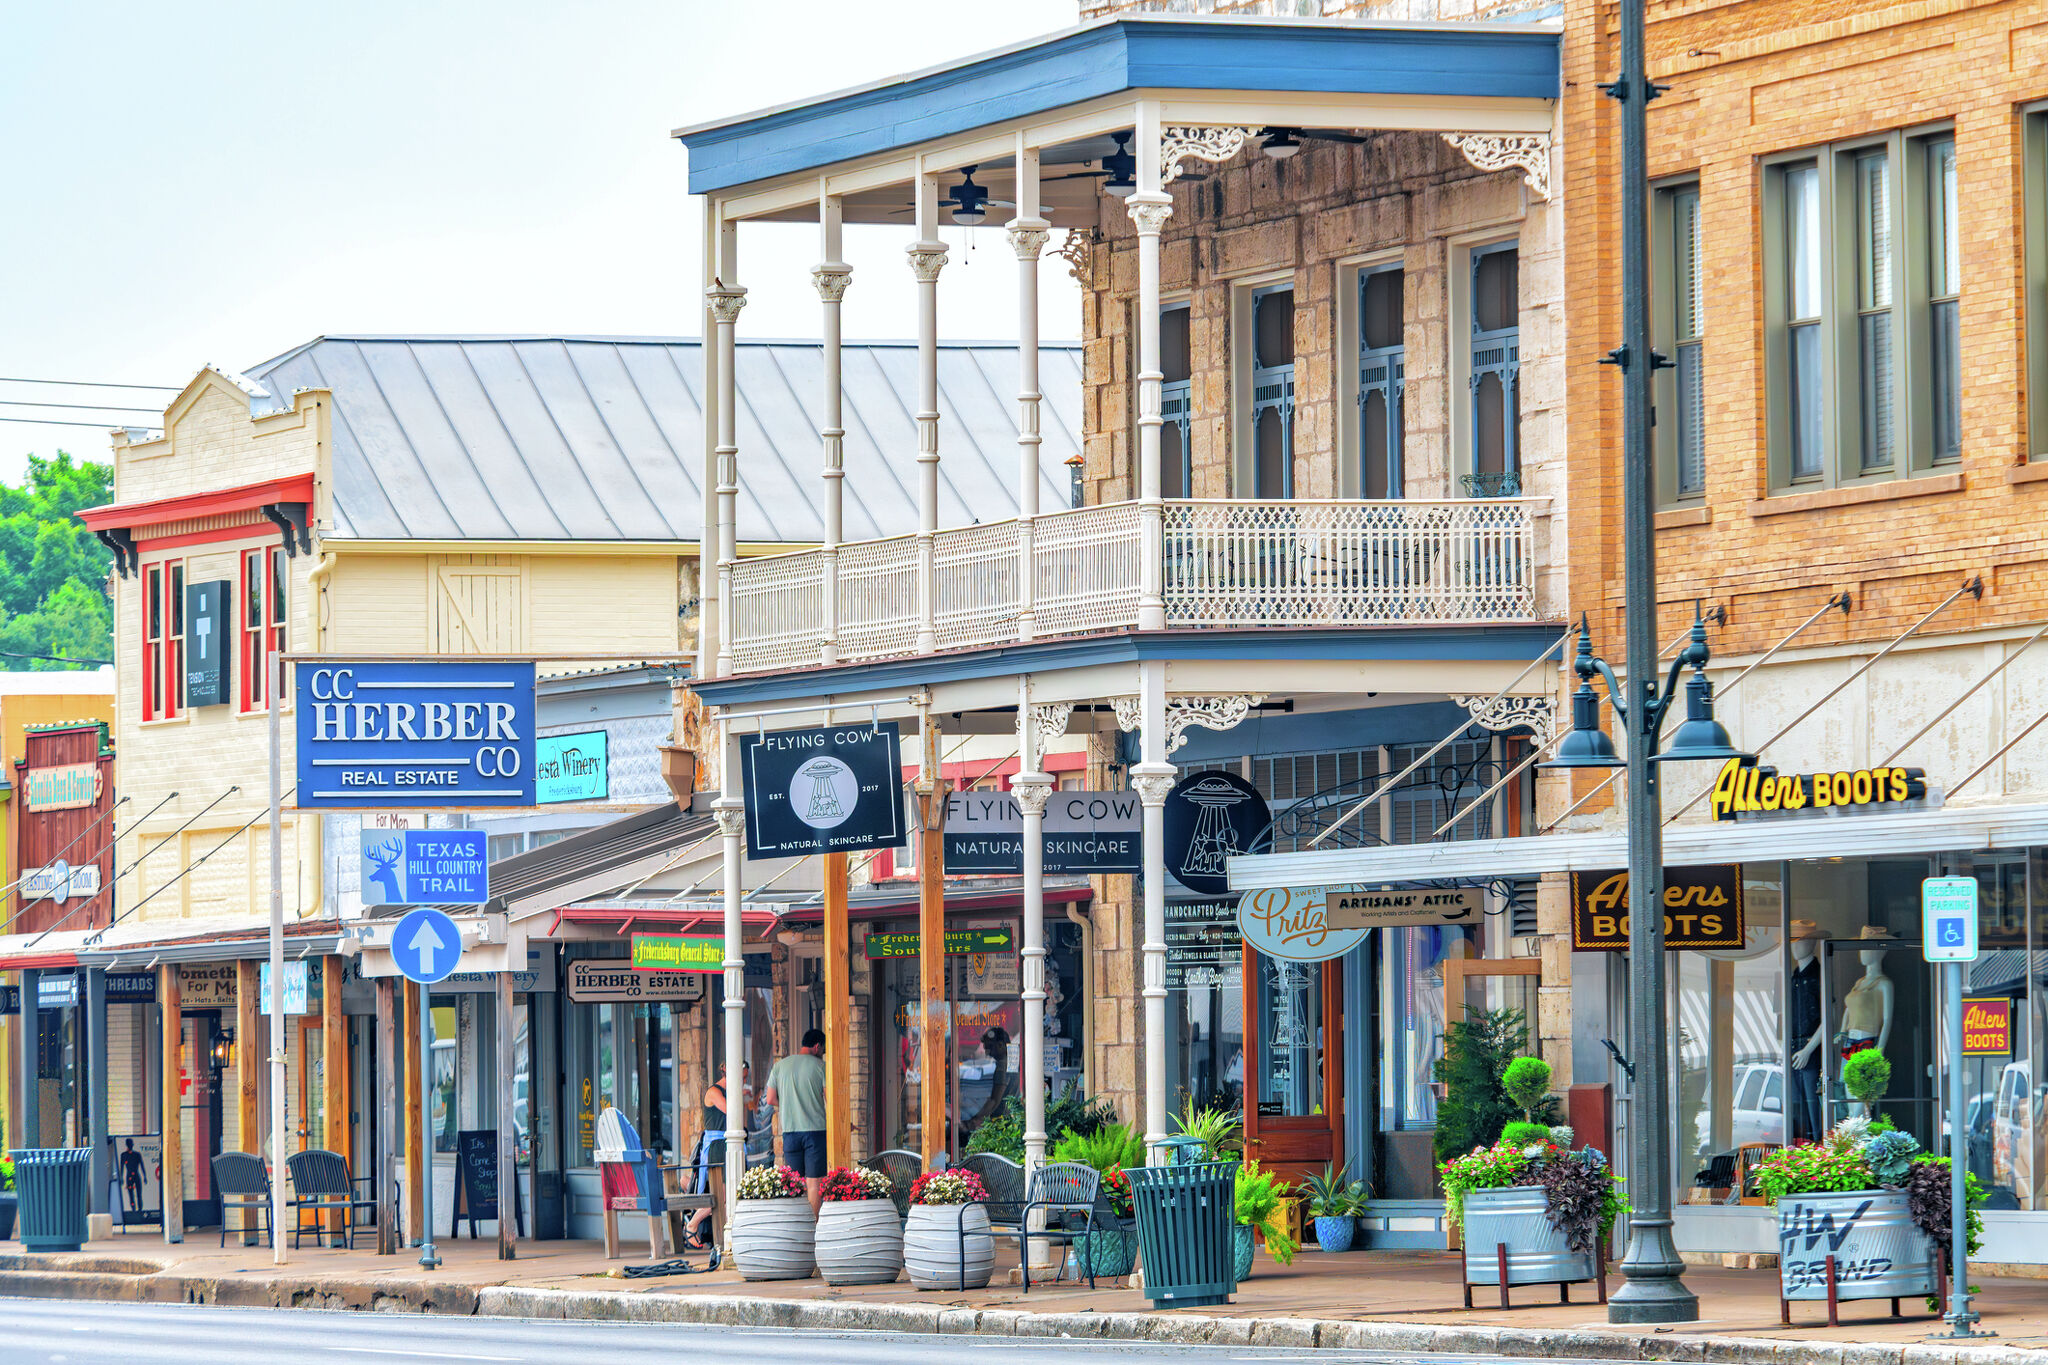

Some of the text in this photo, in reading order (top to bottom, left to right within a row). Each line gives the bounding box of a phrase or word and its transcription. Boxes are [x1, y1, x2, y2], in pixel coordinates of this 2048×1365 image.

[311, 669, 353, 700] CC
[312, 702, 520, 741] HERBER
[767, 730, 873, 750] FLYING COW
[476, 746, 521, 777] CO
[341, 770, 459, 785] REAL ESTATE
[537, 748, 600, 794] esta Winery
[769, 793, 785, 801] EST.
[1710, 758, 1908, 821] Allens BOOTS
[1067, 800, 1135, 820] COW
[376, 814, 409, 830] For Men
[417, 843, 476, 857] TEXAS
[780, 835, 873, 850] NATURAL SKINCARE
[955, 840, 1129, 854] NATURA SKINCARE
[409, 861, 482, 875] HILL COUNTRY
[419, 878, 475, 892] TRAIL
[1295, 887, 1321, 898] SWEET
[1585, 872, 1728, 913] Aens
[1928, 886, 1972, 896] RESERVED
[1339, 894, 1464, 909] ARTISANS' ATTIC
[1930, 900, 1970, 910] PARKING
[1164, 905, 1214, 918] HANDCRAFTED
[1250, 886, 1329, 947] Pritz
[880, 932, 972, 944] Frederburg
[680, 942, 702, 962] General
[703, 943, 720, 962] Store
[882, 943, 971, 956] Souirs
[575, 965, 589, 974] CC
[188, 980, 238, 996] For Me
[576, 975, 694, 987] HERBER ESTATE
[626, 987, 641, 996] CO
[1963, 1005, 2007, 1033] Allens
[1966, 1034, 2005, 1048] BOOTS
